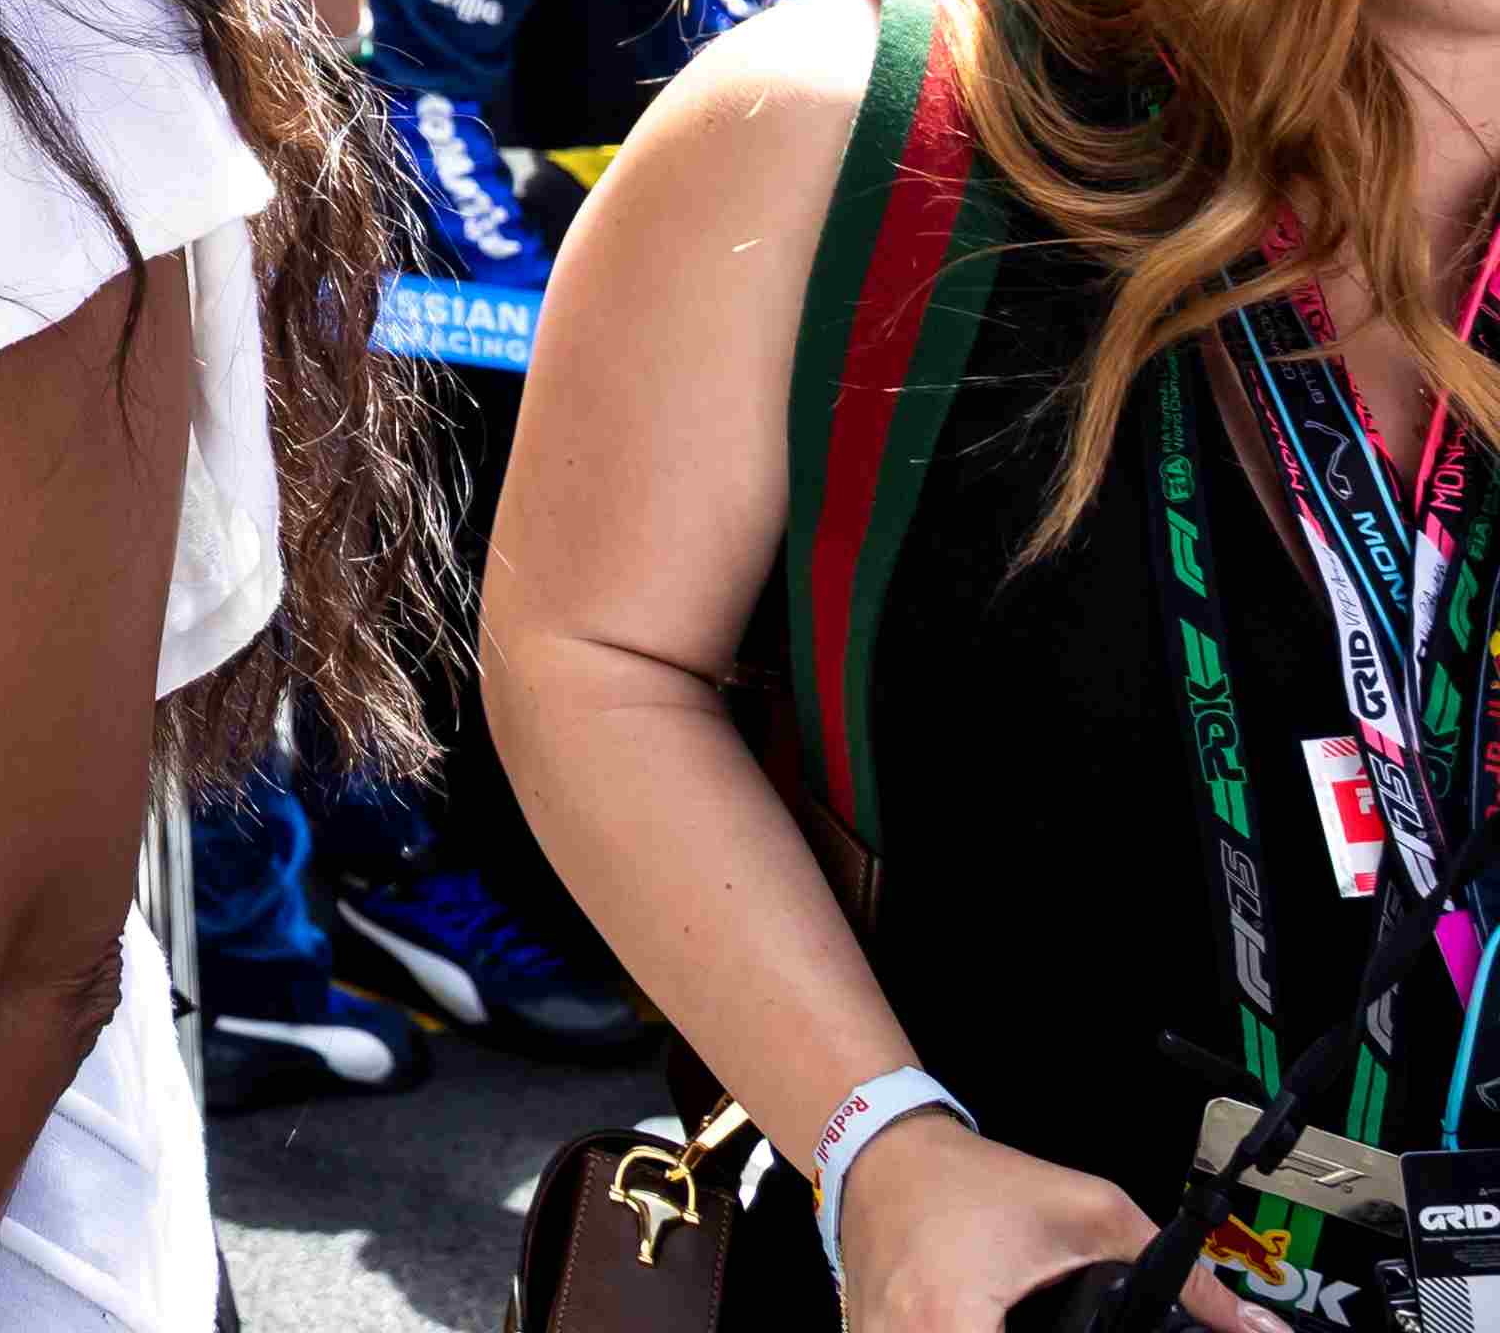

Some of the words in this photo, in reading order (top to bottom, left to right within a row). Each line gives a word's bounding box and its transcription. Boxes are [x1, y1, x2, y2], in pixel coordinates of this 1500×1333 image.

[1160, 455, 1194, 503] FIA
[1165, 506, 1209, 599] F1
[1347, 629, 1386, 721] GRID
[1229, 908, 1274, 1016] F1
[1418, 1202, 1500, 1231] GRID
